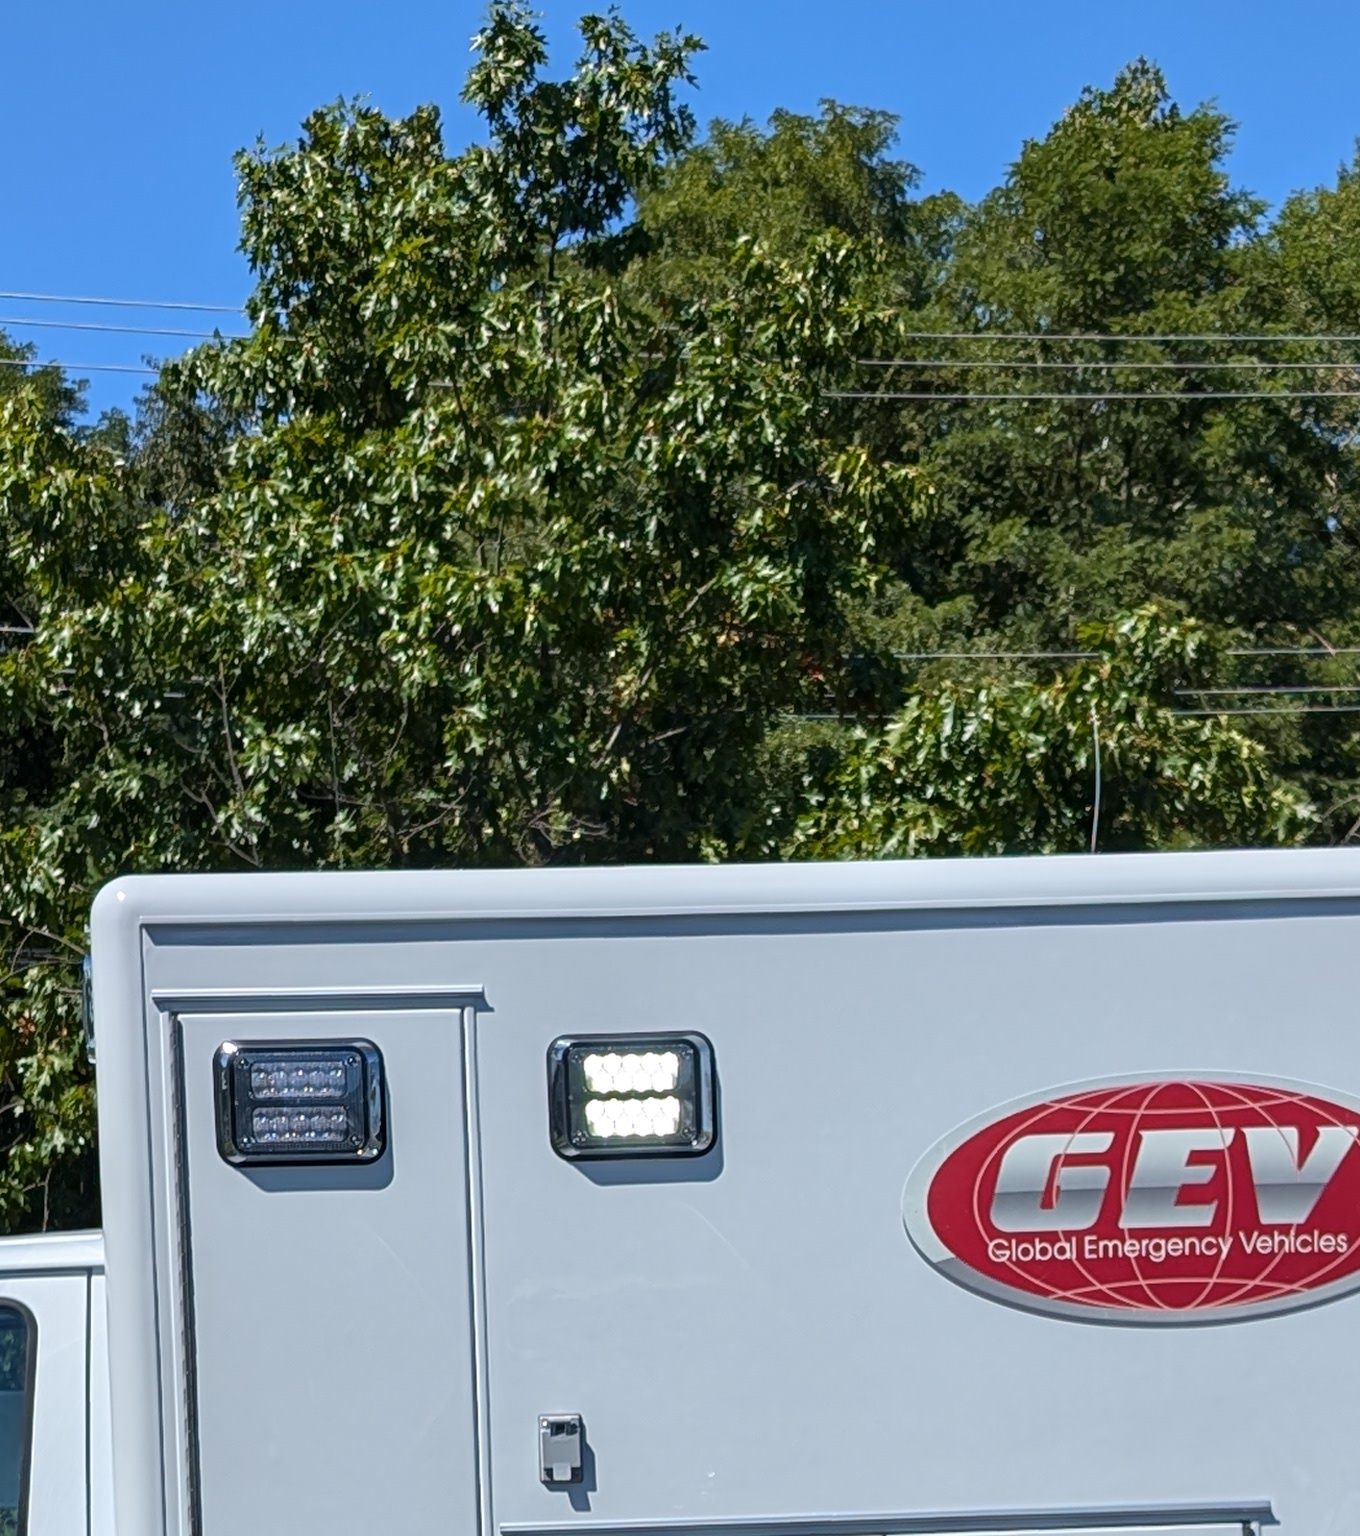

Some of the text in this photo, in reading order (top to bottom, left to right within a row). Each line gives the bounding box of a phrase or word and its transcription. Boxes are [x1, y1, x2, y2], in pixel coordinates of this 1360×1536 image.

[989, 1126, 1359, 1232] GEV
[988, 1229, 1348, 1262] Global Emergency Vehicles
